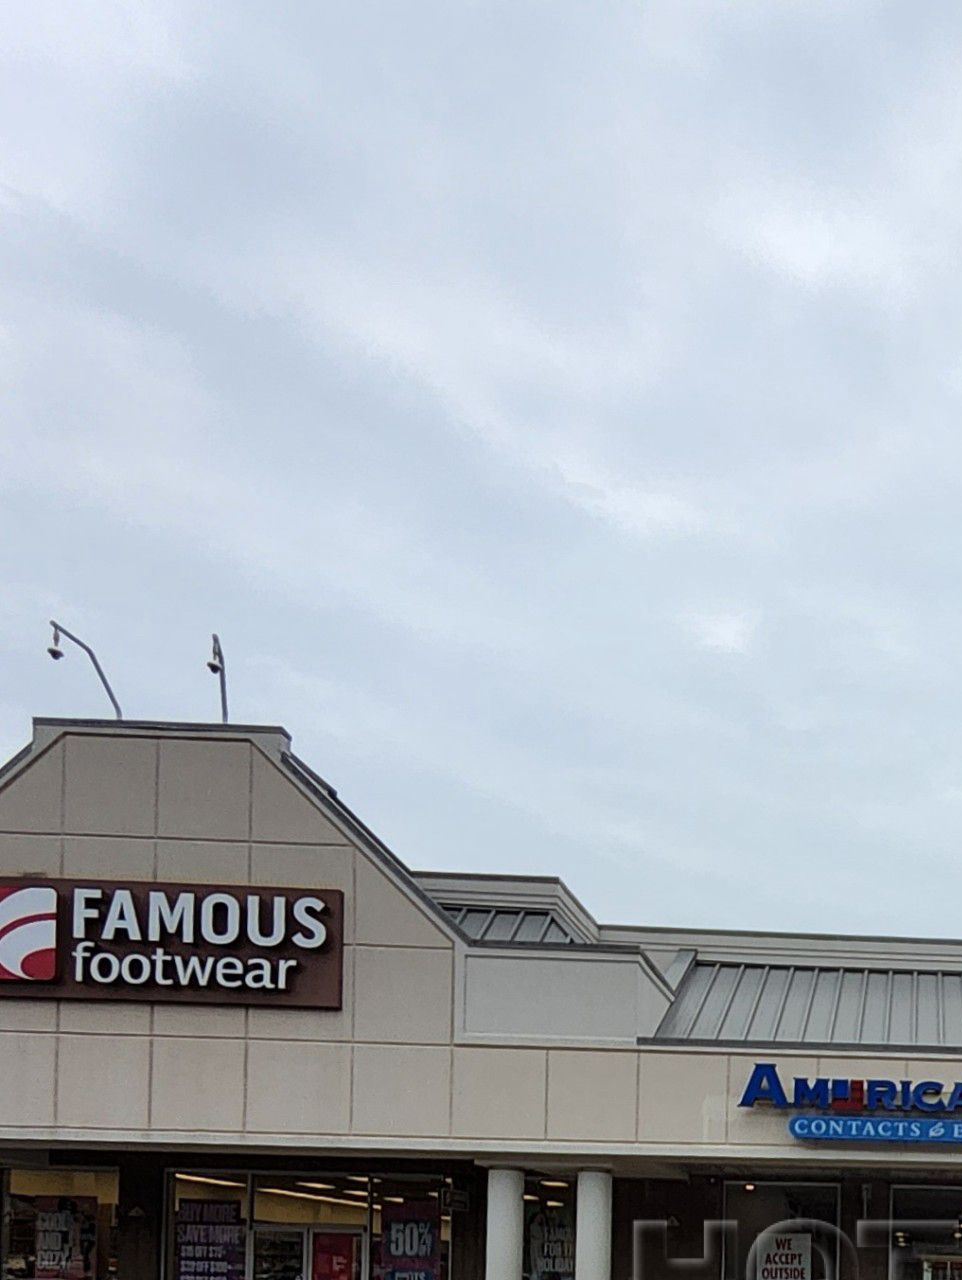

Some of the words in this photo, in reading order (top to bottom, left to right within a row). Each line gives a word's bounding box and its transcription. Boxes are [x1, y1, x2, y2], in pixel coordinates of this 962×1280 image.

[71, 887, 328, 949] FAMOUS
[71, 941, 298, 990] footwear
[793, 1118, 921, 1138] CONTACTS
[775, 1238, 793, 1251] WE
[765, 1252, 803, 1266] ACCEPT
[761, 1266, 807, 1280] OUTSIDE
